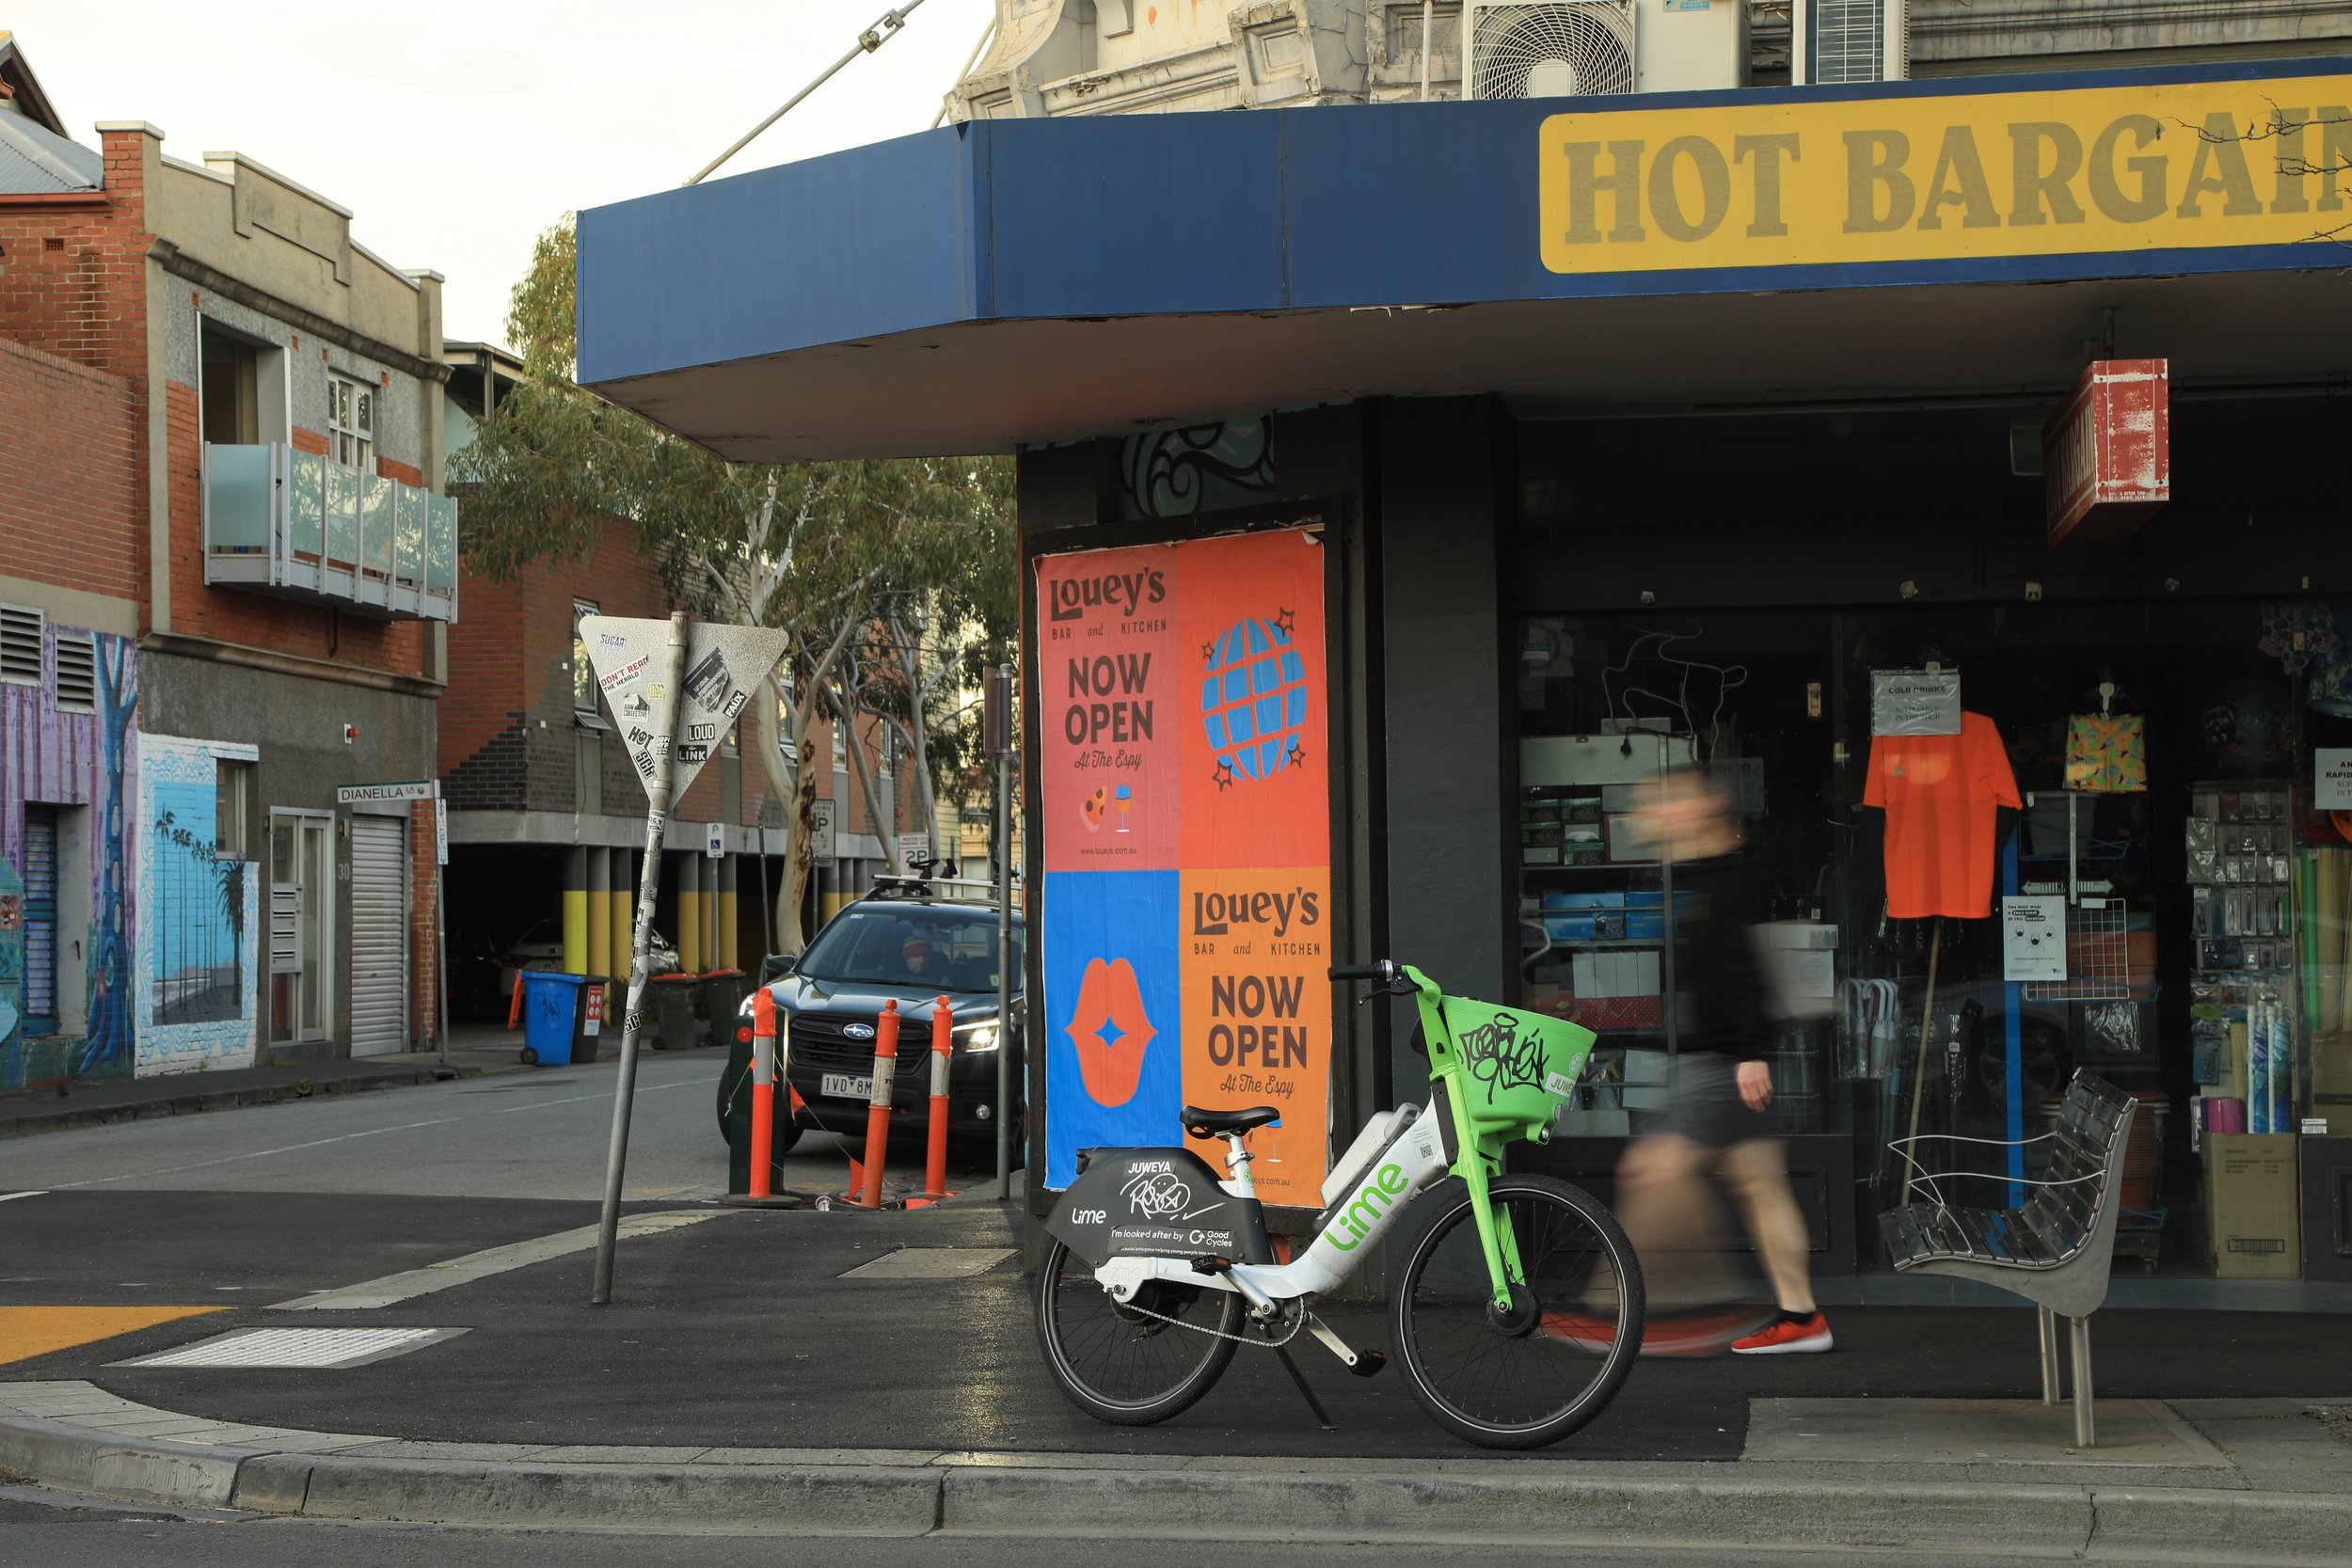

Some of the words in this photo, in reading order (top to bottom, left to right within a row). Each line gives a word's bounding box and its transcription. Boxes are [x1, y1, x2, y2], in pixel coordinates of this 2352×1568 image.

[1564, 133, 1801, 245] HOT
[1050, 567, 1166, 621] Louey's
[1052, 628, 1072, 640] BAR
[1088, 624, 1104, 637] and
[1120, 619, 1167, 633] KITCHEN
[599, 634, 626, 648] SUGAR
[600, 669, 626, 687] DON'T
[627, 657, 649, 673] READ
[1069, 653, 1152, 698] NOW
[603, 684, 615, 692] THE
[616, 671, 640, 687] HERALD
[1913, 686, 1946, 694] DRINKS
[1065, 701, 1153, 745] OPEN
[689, 725, 715, 740] LOUD
[678, 751, 707, 761] LINK
[1074, 752, 1090, 768] At
[1091, 751, 1113, 768] The
[1115, 749, 1142, 770] Espy
[342, 788, 404, 800] DIANELLA
[906, 849, 927, 863] 2P
[339, 863, 350, 880] 30
[1194, 887, 1320, 937] Louey's
[1194, 943, 1215, 956] BAR
[1233, 942, 1251, 955] and
[1271, 942, 1321, 956] KITCHEN
[1212, 975, 1305, 1018] NOW
[1208, 1024, 1308, 1069] OPEN
[826, 1078, 847, 1092] 1VD
[857, 1081, 873, 1095] 8M
[1220, 1073, 1238, 1092] At
[1239, 1074, 1263, 1094] The
[1264, 1074, 1295, 1099] Espy
[1550, 1078, 1574, 1094] JUWE
[1128, 1162, 1171, 1174] JUWEYA
[1072, 1208, 1106, 1224] Lime
[1323, 1164, 1408, 1251] Lime
[1111, 1229, 1122, 1238] I'm
[1123, 1229, 1151, 1239] looked
[1152, 1229, 1172, 1239] after
[1173, 1231, 1184, 1242] by
[1206, 1238, 1232, 1247] Cycles
[1207, 1230, 1230, 1239] Good
